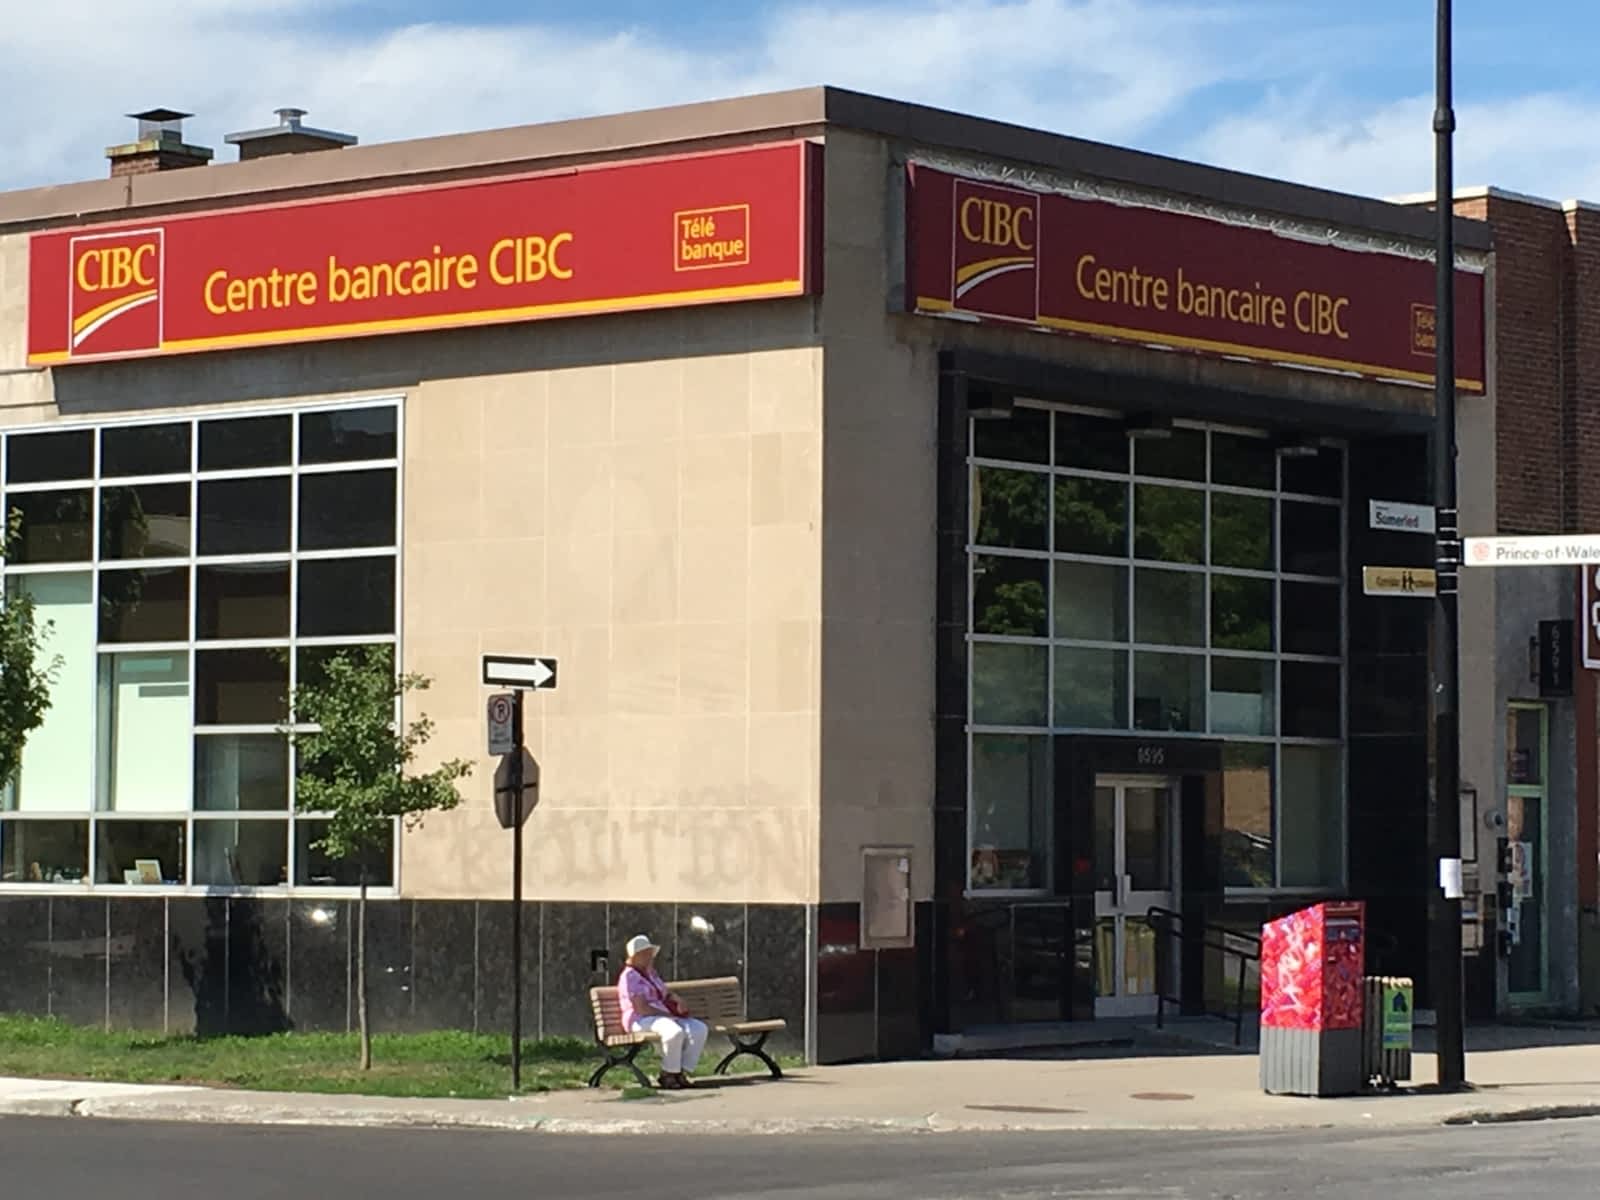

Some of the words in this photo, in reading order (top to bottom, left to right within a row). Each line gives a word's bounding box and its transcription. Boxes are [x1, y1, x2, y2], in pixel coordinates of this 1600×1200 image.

[681, 215, 716, 239] Télé
[960, 196, 1034, 251] CIBC
[77, 243, 156, 292] CIBC
[204, 267, 318, 315] Centre
[328, 244, 479, 303] bancaire
[489, 232, 574, 286] CIBC
[681, 239, 745, 261] banque
[1076, 254, 1169, 311] Centre
[1177, 266, 1287, 329] bancaire
[1294, 289, 1349, 340] CIBC
